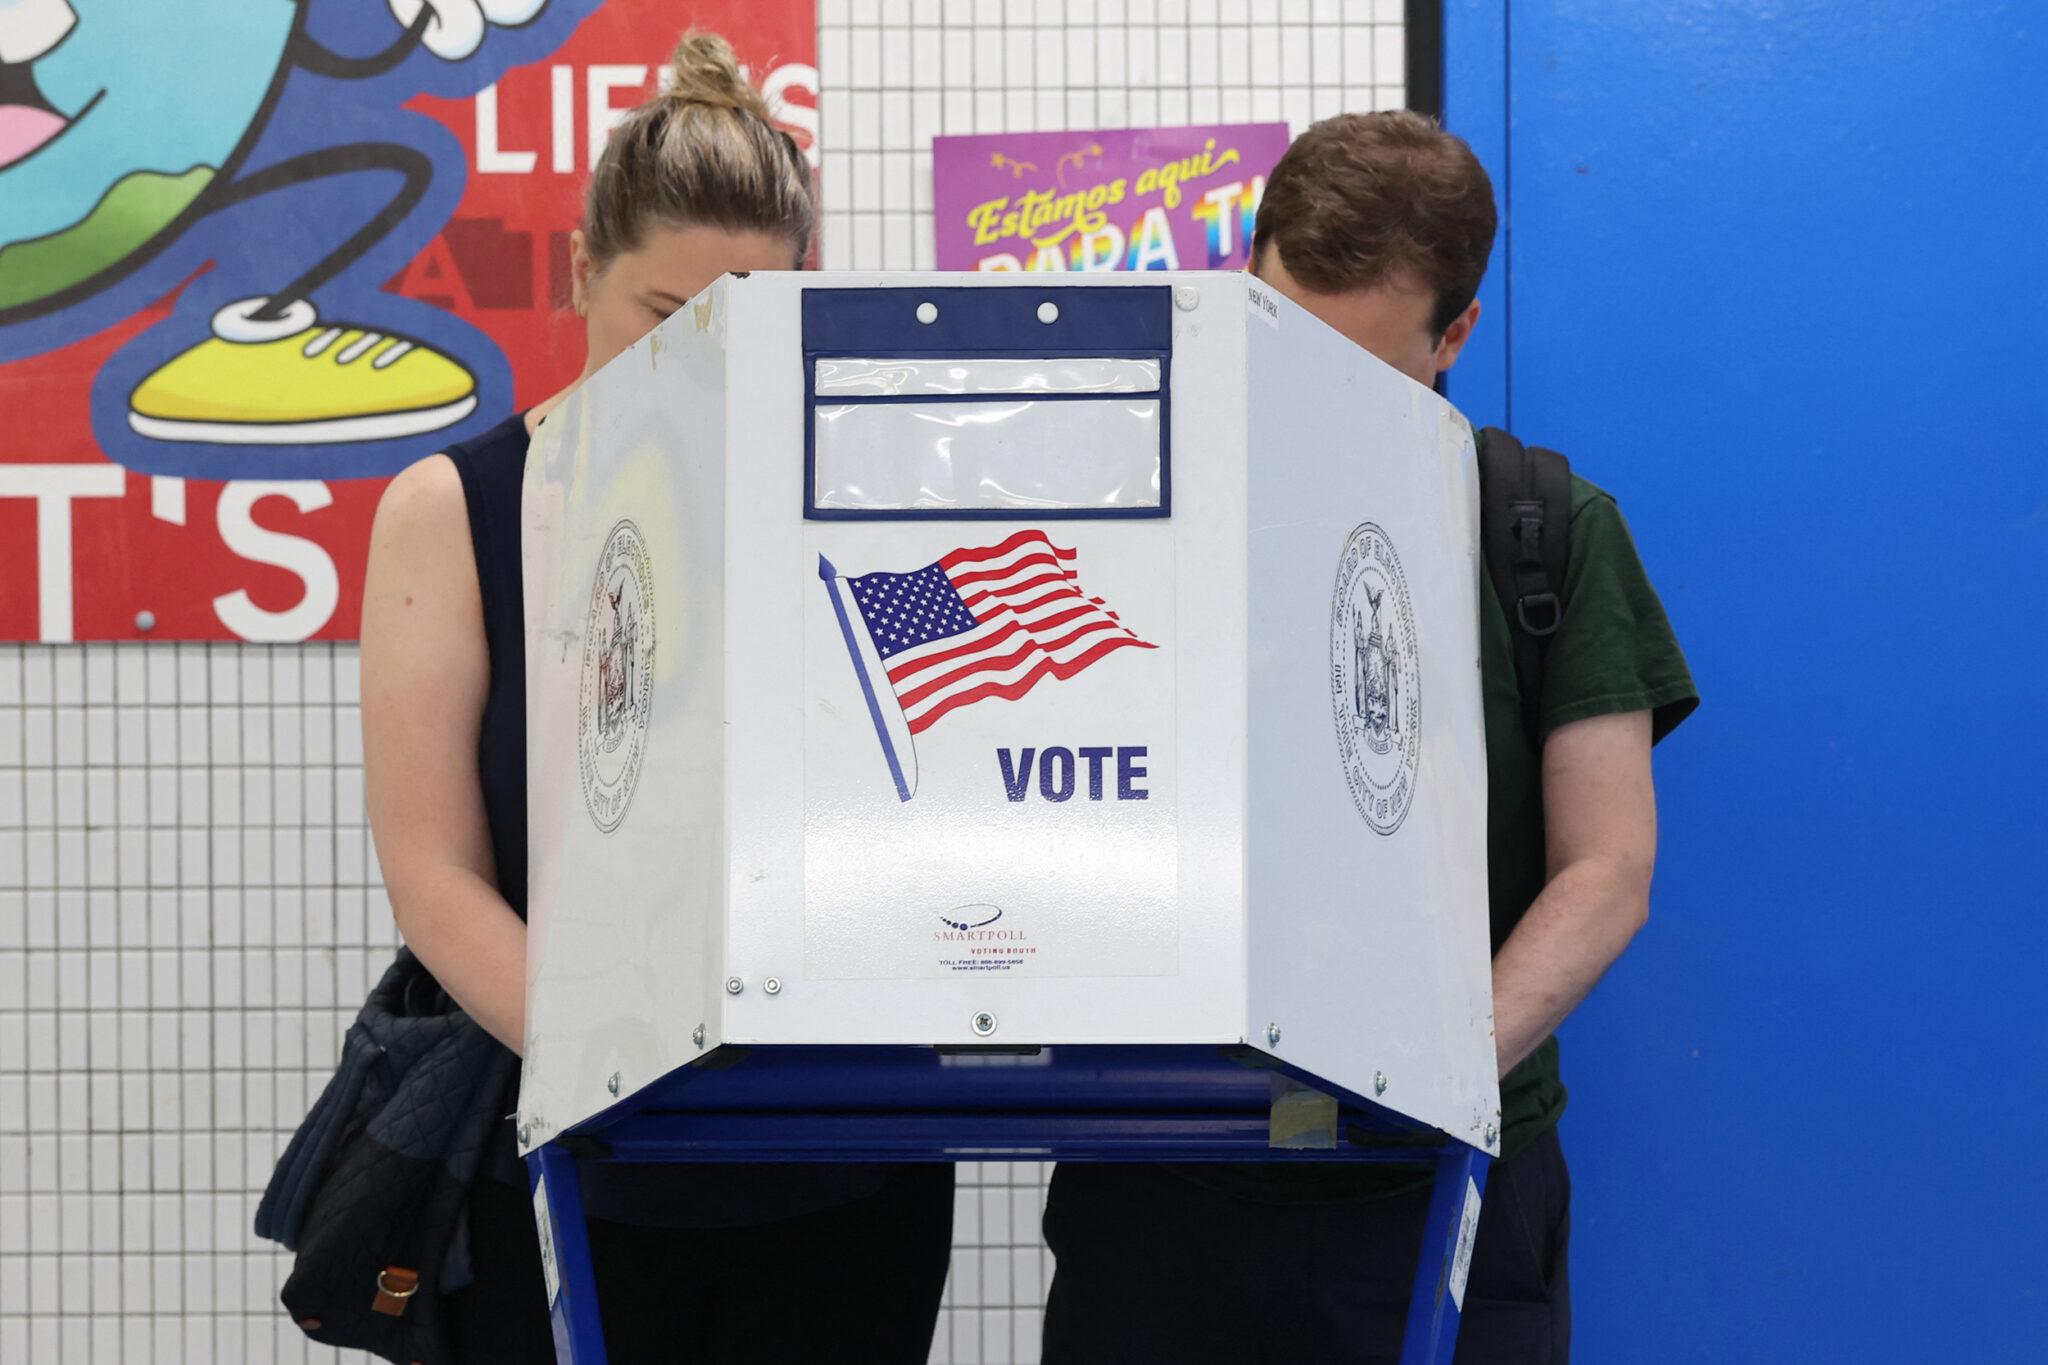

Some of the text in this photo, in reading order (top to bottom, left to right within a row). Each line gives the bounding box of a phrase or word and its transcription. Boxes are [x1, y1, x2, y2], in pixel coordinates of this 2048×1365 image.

[475, 63, 818, 172] LIFS
[967, 177, 1127, 248] Estamos
[972, 206, 1181, 271] RA
[1248, 287, 1278, 318] NEW YORK
[996, 746, 1149, 802] VOTE
[934, 931, 1027, 942] SMARTPOLL
